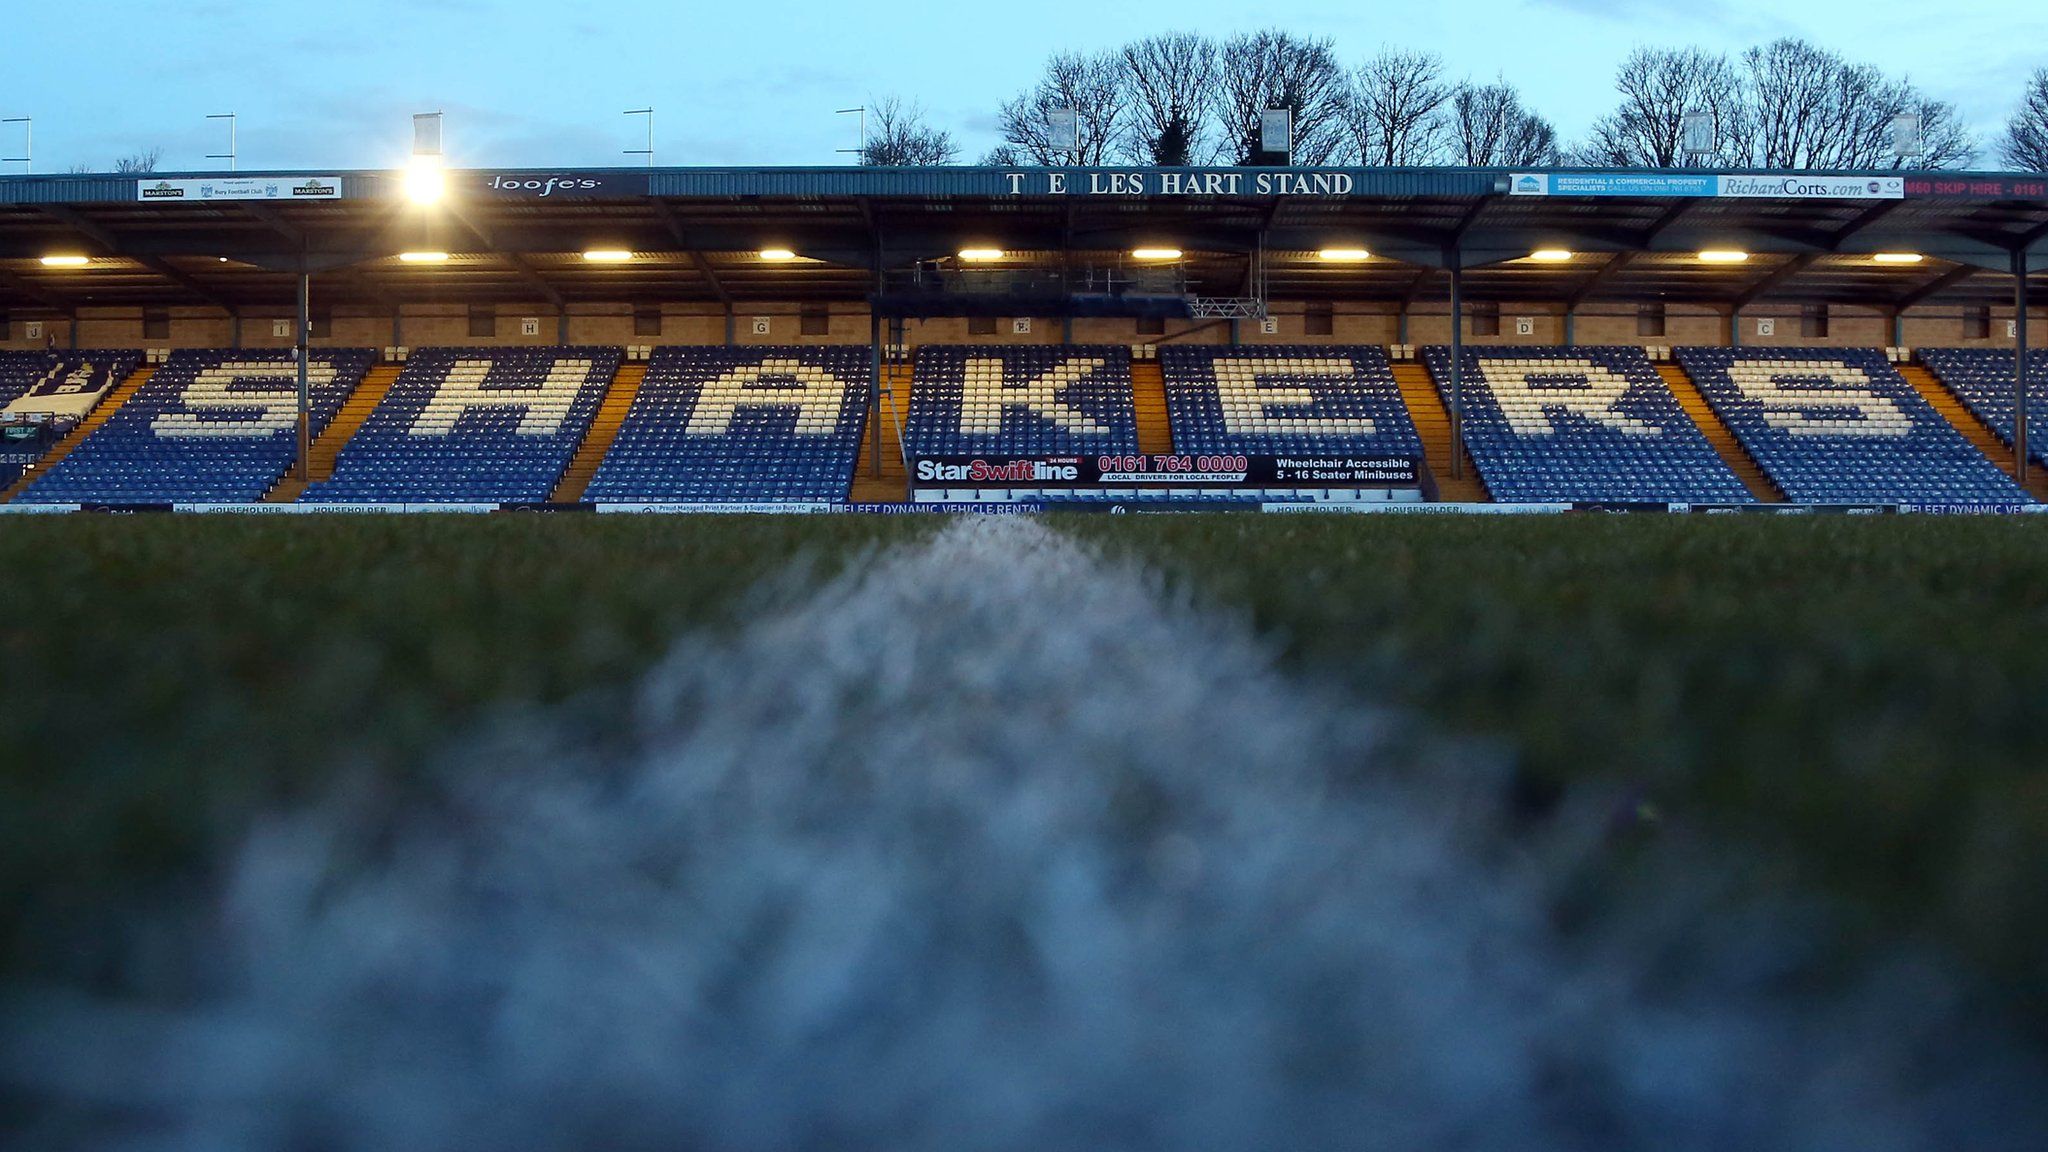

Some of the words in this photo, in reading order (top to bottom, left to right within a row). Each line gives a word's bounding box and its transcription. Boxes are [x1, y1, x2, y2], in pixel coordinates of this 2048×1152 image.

[1089, 173, 1144, 195] LES
[1160, 173, 1243, 195] HART
[1255, 173, 1353, 196] STAND
[1724, 178, 1863, 196] RichardCorts.com
[1934, 181, 1967, 194] SKIP
[1969, 182, 2003, 195] HIRE
[2013, 183, 2045, 195] 0161
[31, 327, 37, 337] J
[527, 324, 534, 333] H
[757, 323, 765, 332] G
[1266, 323, 1272, 332] E
[1521, 323, 1528, 333] D
[1762, 325, 1769, 334] C
[150, 357, 1914, 438] SHAKERS
[1098, 456, 1147, 472] 0161
[1154, 456, 1193, 472] 764
[1197, 456, 1248, 472] 0000
[1276, 458, 1343, 468] Wheelchair
[1345, 458, 1411, 468] Accessible
[917, 459, 1078, 481] StarSwiftline
[1276, 470, 1284, 479] 5
[1295, 470, 1309, 479] 16
[1312, 470, 1350, 480] Seater
[1354, 470, 1413, 480] Minibuses
[843, 504, 880, 514] FLEET
[883, 504, 938, 514] DYNAMIC
[942, 504, 993, 515] VEHICLE
[996, 504, 1041, 515] RENTAL
[1912, 504, 1947, 514] FLEET
[1950, 504, 2000, 515] DYNAMIC
